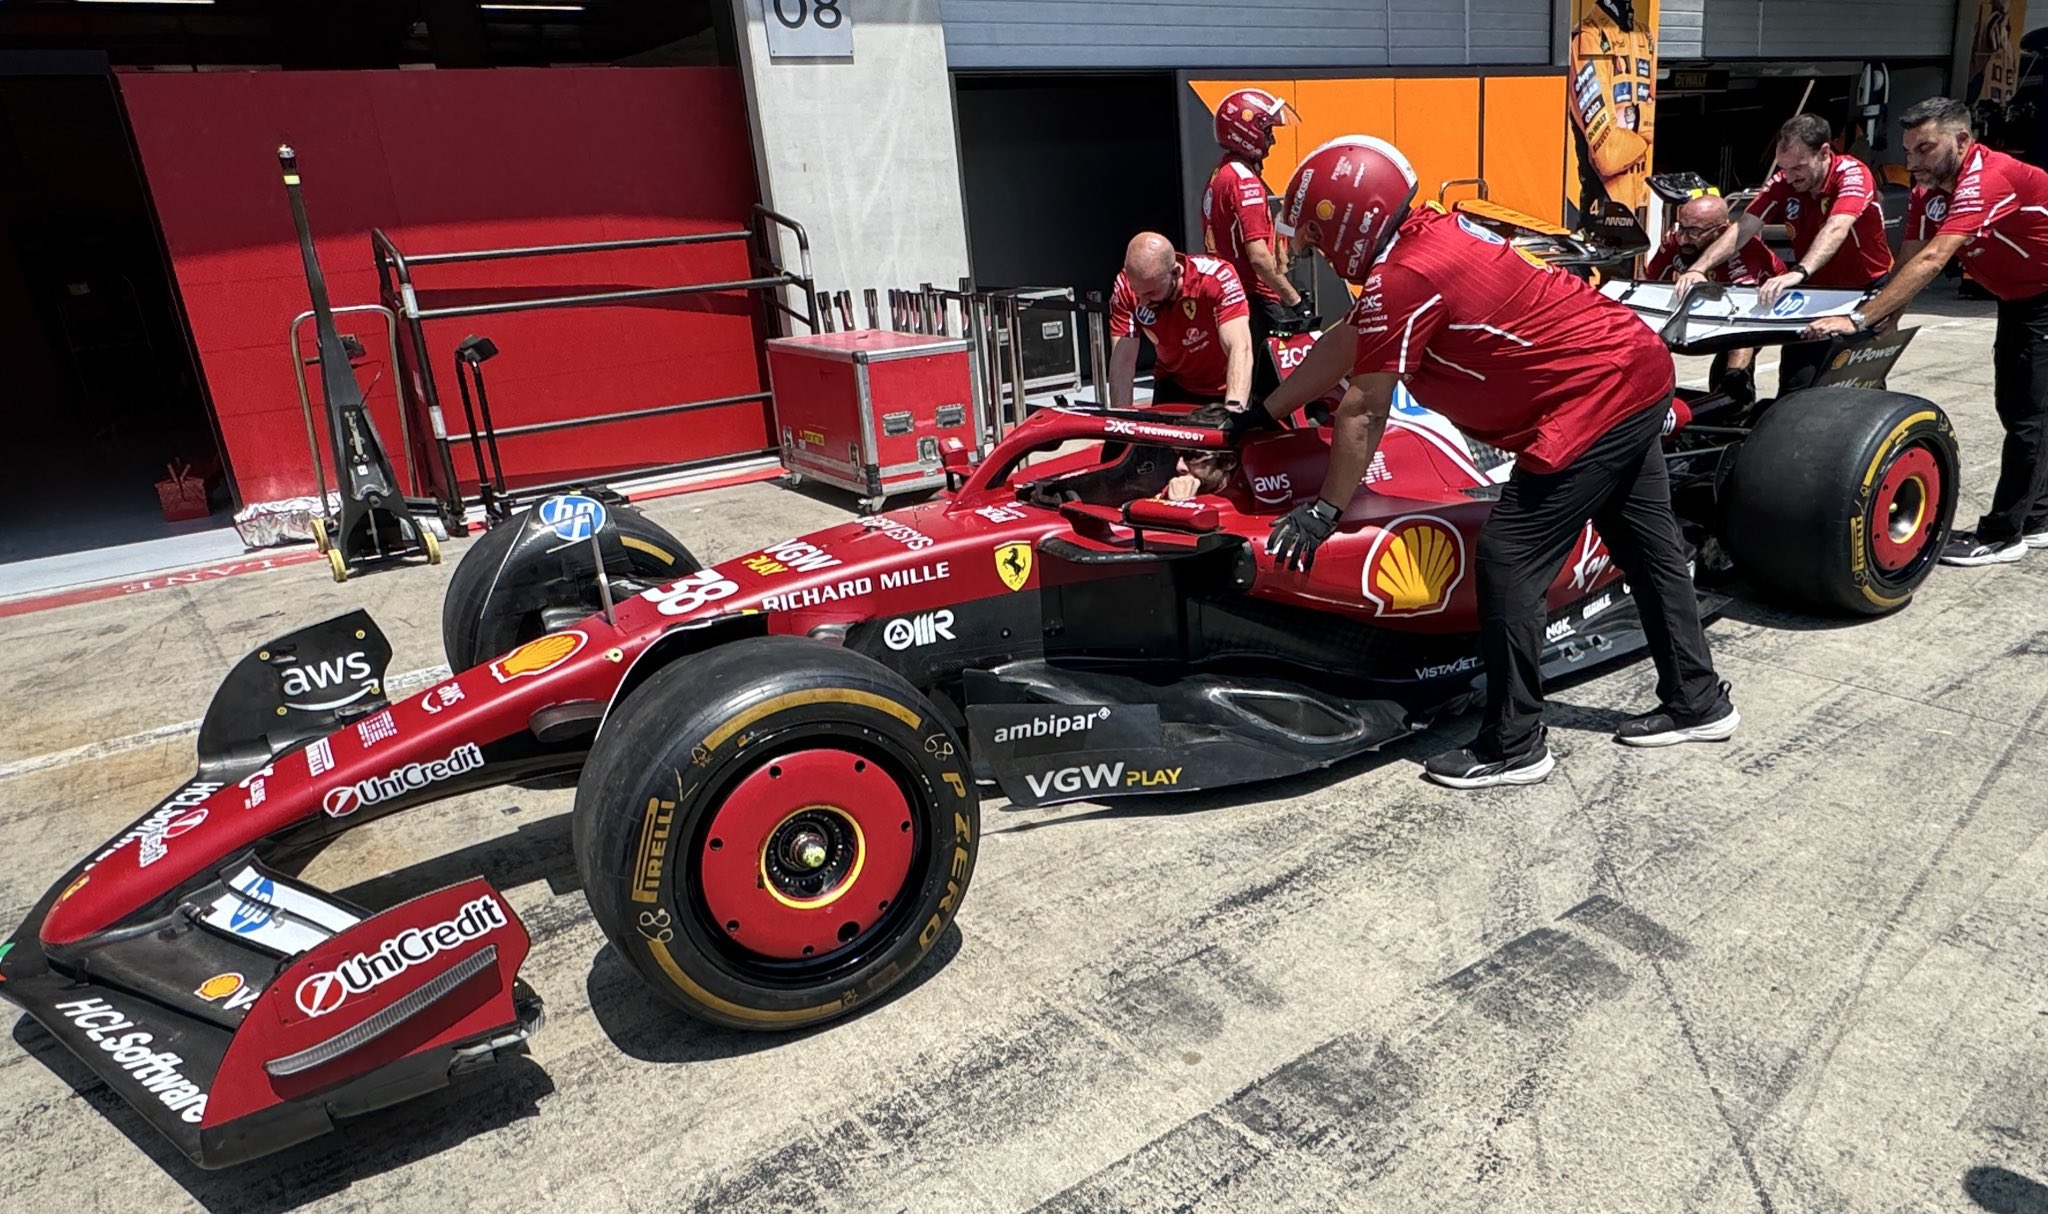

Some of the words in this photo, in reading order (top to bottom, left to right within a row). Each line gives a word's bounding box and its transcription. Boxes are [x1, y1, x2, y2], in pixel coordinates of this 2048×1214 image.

[773, 0, 843, 29] 08
[1775, 292, 1804, 316] hp
[1847, 344, 1902, 366] V-Power
[1137, 425, 1205, 442] TECHNOLOGY
[1254, 473, 1291, 493] aws
[548, 495, 600, 540] hp
[741, 555, 789, 577] PLAY
[761, 538, 843, 573] VGW
[640, 569, 740, 616] 38
[762, 577, 873, 612] RICHARD
[880, 562, 950, 590] MILLE
[1546, 616, 1572, 640] NGK
[281, 651, 372, 696] aws
[994, 712, 1098, 743] ambipar
[359, 744, 483, 803] UniCredit
[1025, 762, 1125, 798] VGW
[1126, 767, 1183, 787] PLAY
[632, 797, 676, 903] PIRELLI
[917, 810, 973, 955] ZERO
[340, 896, 506, 992] UniCredit
